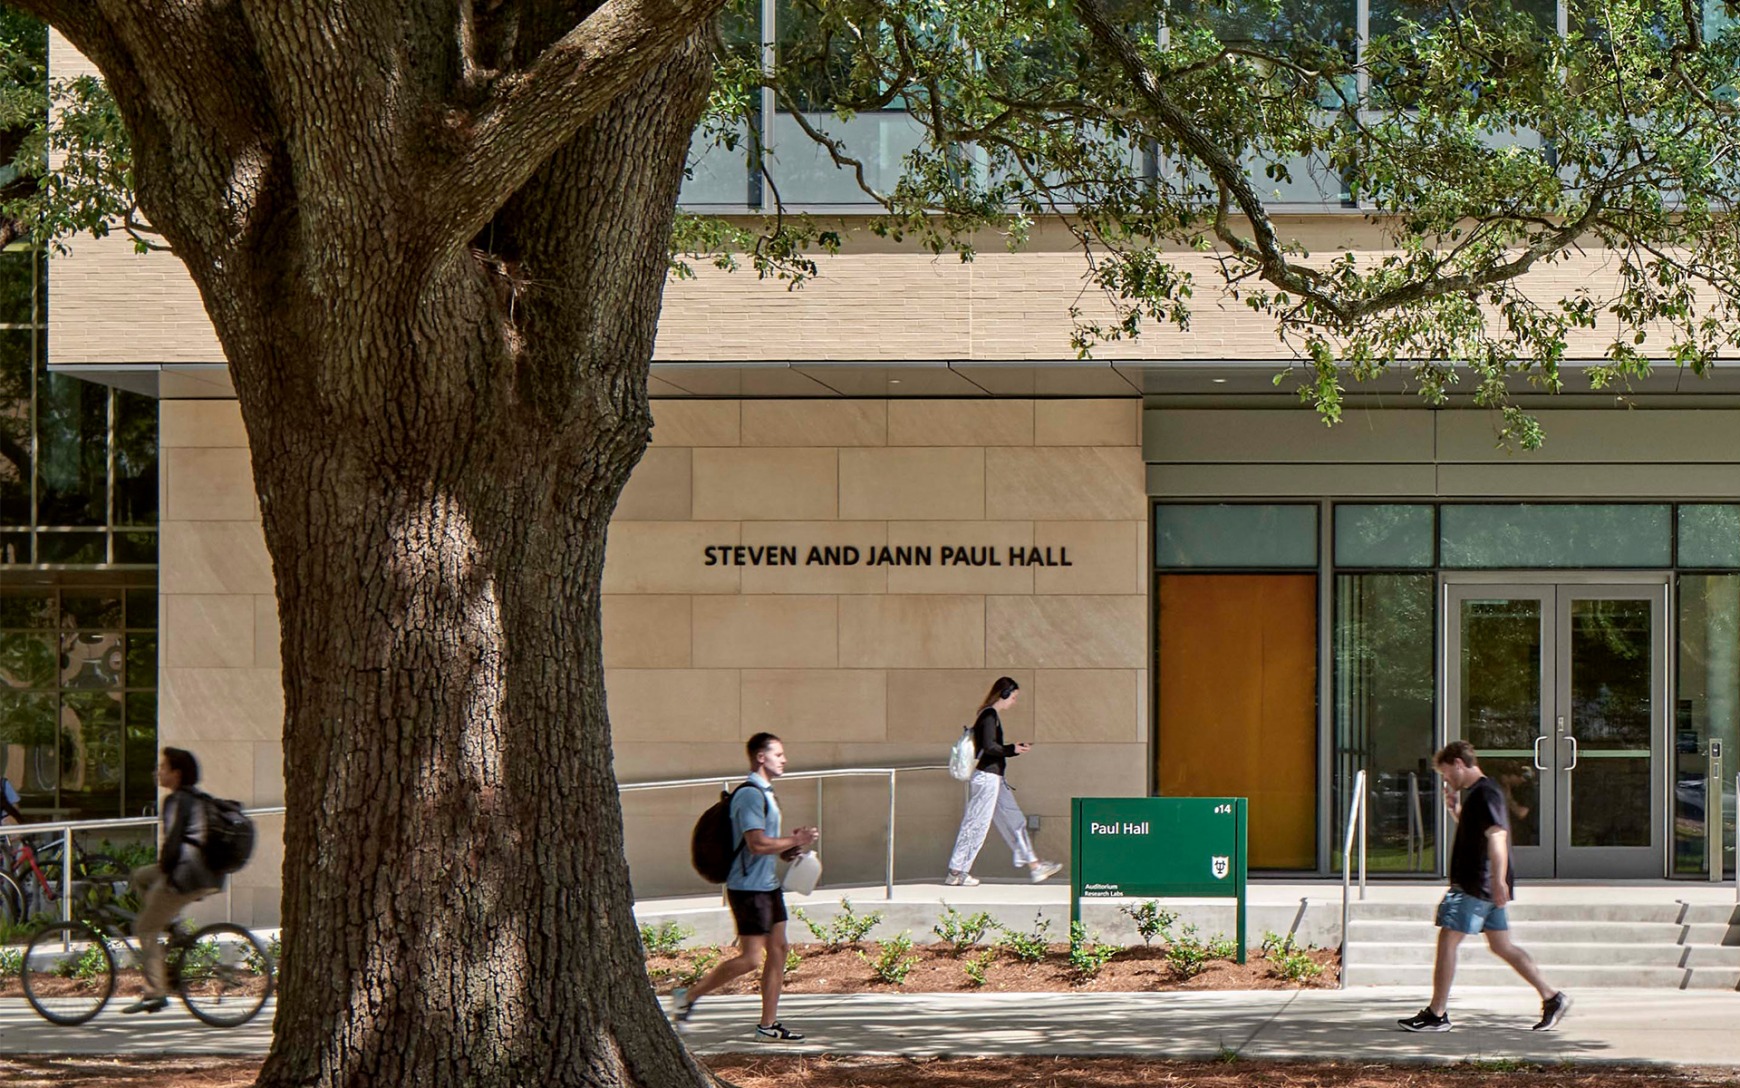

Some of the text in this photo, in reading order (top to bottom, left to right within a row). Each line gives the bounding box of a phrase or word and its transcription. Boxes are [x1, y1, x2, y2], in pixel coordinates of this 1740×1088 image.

[704, 546, 1073, 567] STEVEN AND JANN PAUL HALL
[1214, 804, 1231, 814] #14
[1091, 822, 1149, 834] Paul Hall
